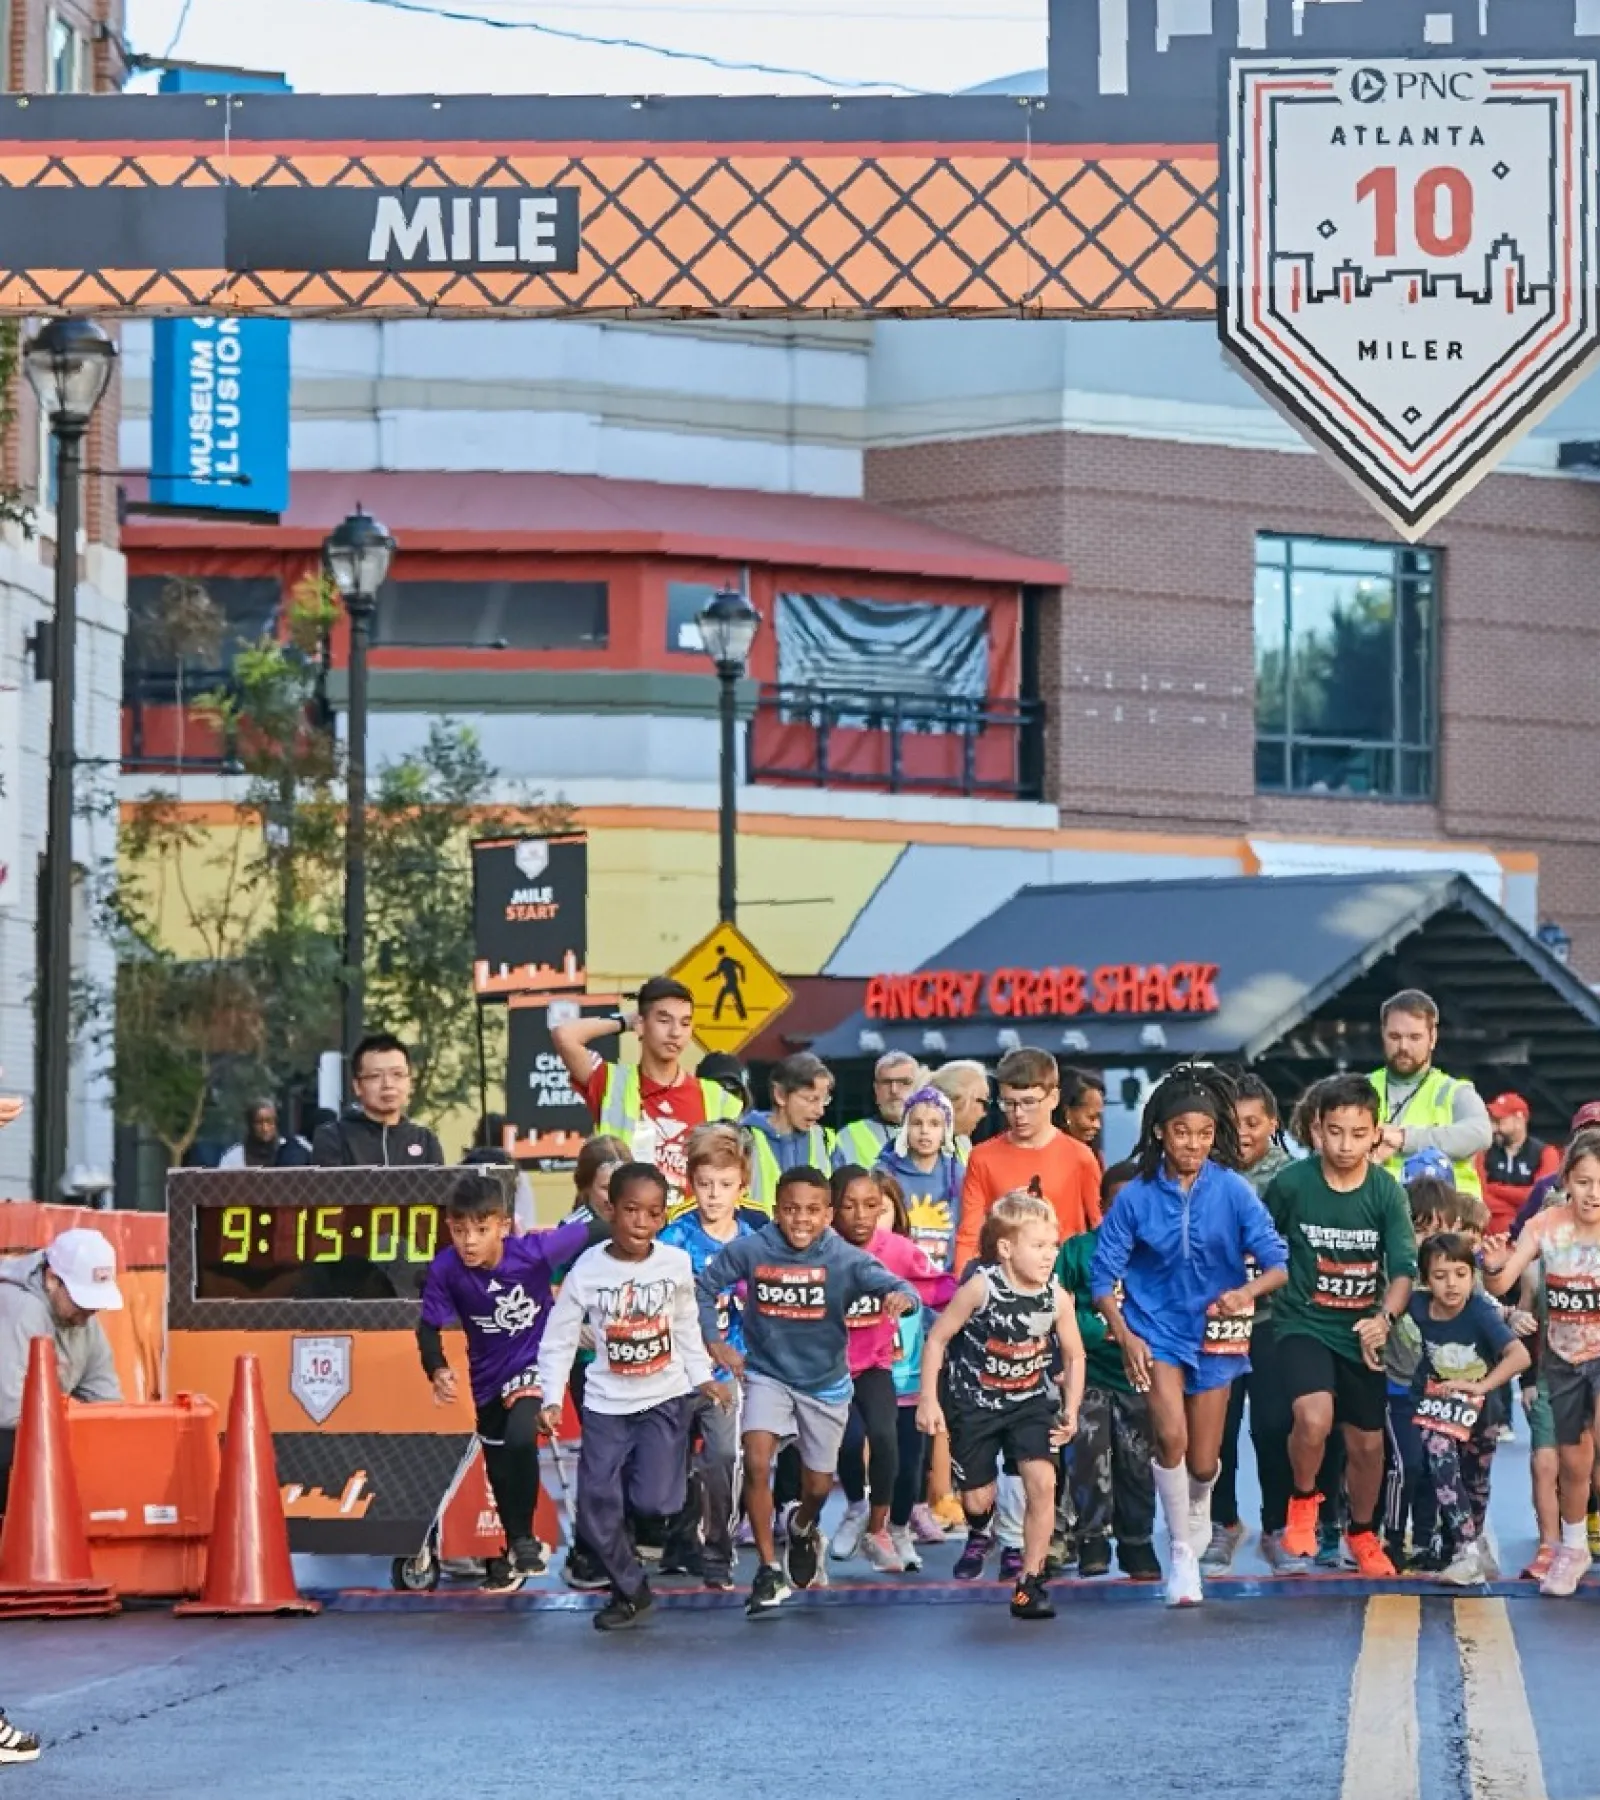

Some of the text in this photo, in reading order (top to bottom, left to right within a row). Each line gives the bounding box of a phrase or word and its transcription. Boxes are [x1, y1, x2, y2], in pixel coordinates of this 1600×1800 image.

[1395, 71, 1475, 101] PNC
[1330, 125, 1486, 146] ATLANTA
[1356, 165, 1474, 258] 10
[368, 196, 558, 262] MILE
[1358, 340, 1464, 361] MILER
[189, 340, 215, 485] MUSEUM
[511, 886, 553, 904] MILE
[505, 903, 559, 921] START
[865, 962, 1220, 1019] ANGRY CRAB SHACK
[757, 1282, 825, 1305] 39612
[608, 1335, 670, 1361] 39651
[1416, 1398, 1478, 1427] 39610
